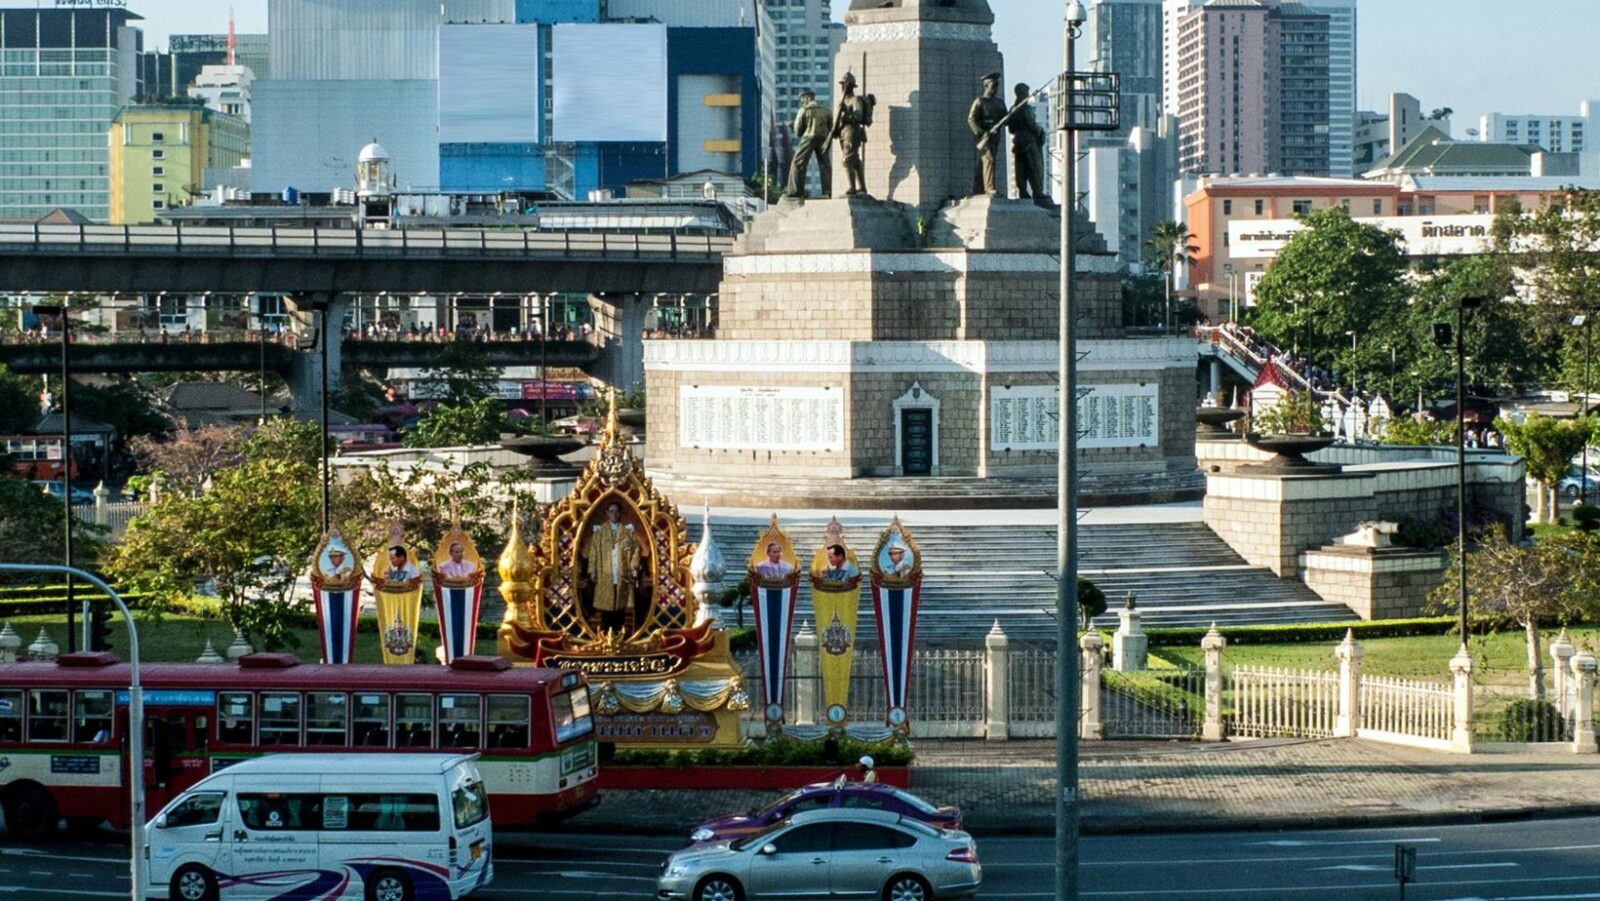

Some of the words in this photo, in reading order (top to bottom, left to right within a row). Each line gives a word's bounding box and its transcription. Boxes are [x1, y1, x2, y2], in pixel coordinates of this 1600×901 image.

[558, 656, 665, 673] ทรงพระเจริญ
